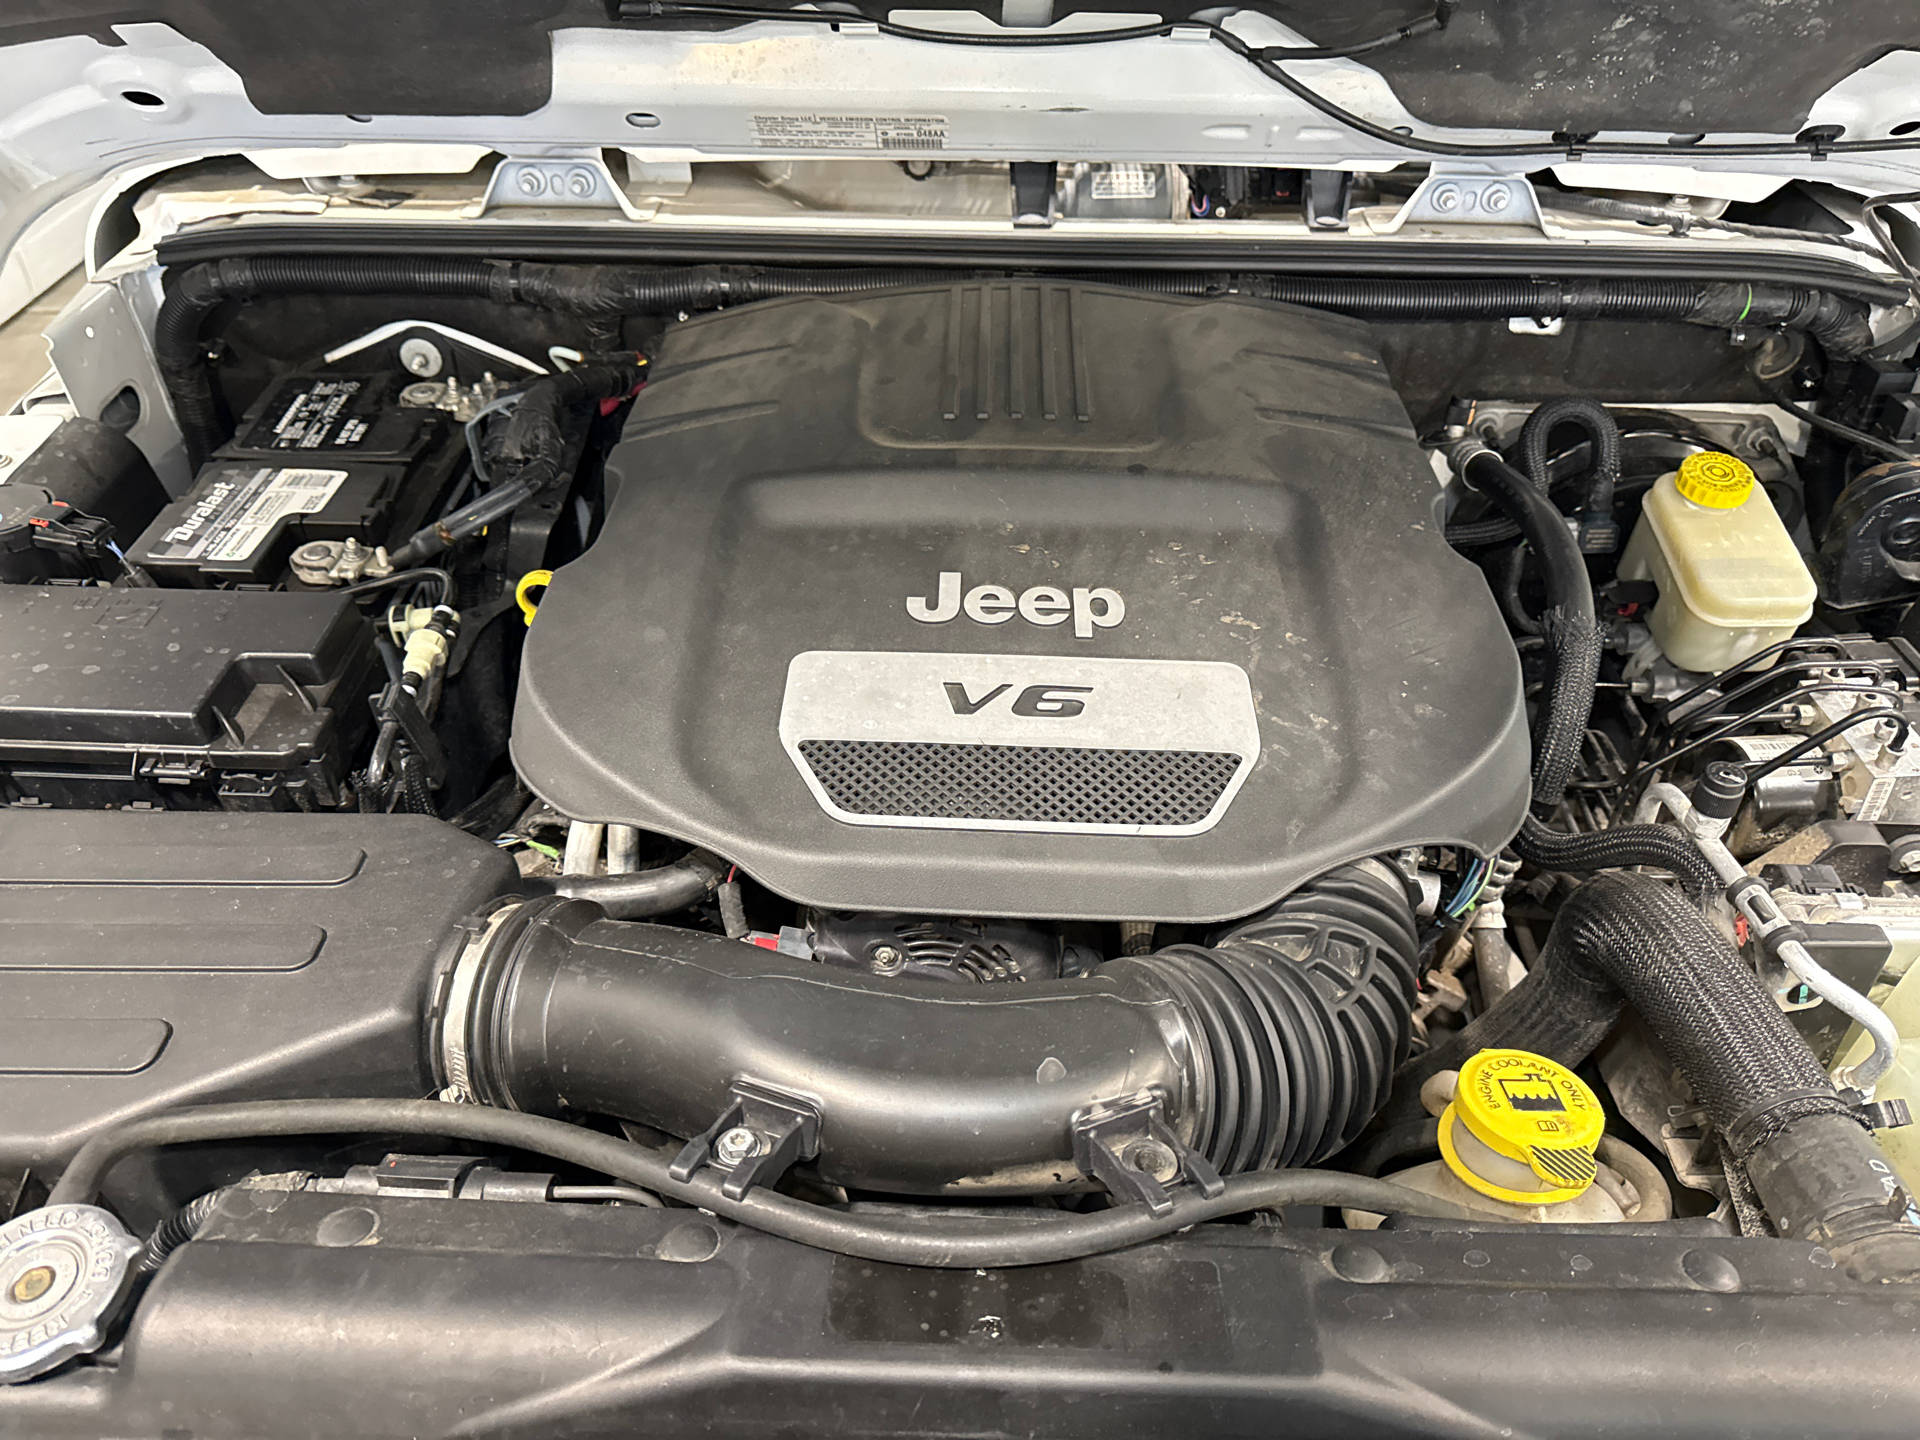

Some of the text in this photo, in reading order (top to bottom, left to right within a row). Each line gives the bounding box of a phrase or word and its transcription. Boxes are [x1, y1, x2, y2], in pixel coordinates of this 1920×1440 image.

[916, 130, 946, 138] 048AA
[164, 481, 236, 543] Duralast
[906, 571, 1126, 638] Jeep
[942, 681, 1094, 717] V6
[1476, 1058, 1587, 1111] ENGINE COOLANT ONLY
